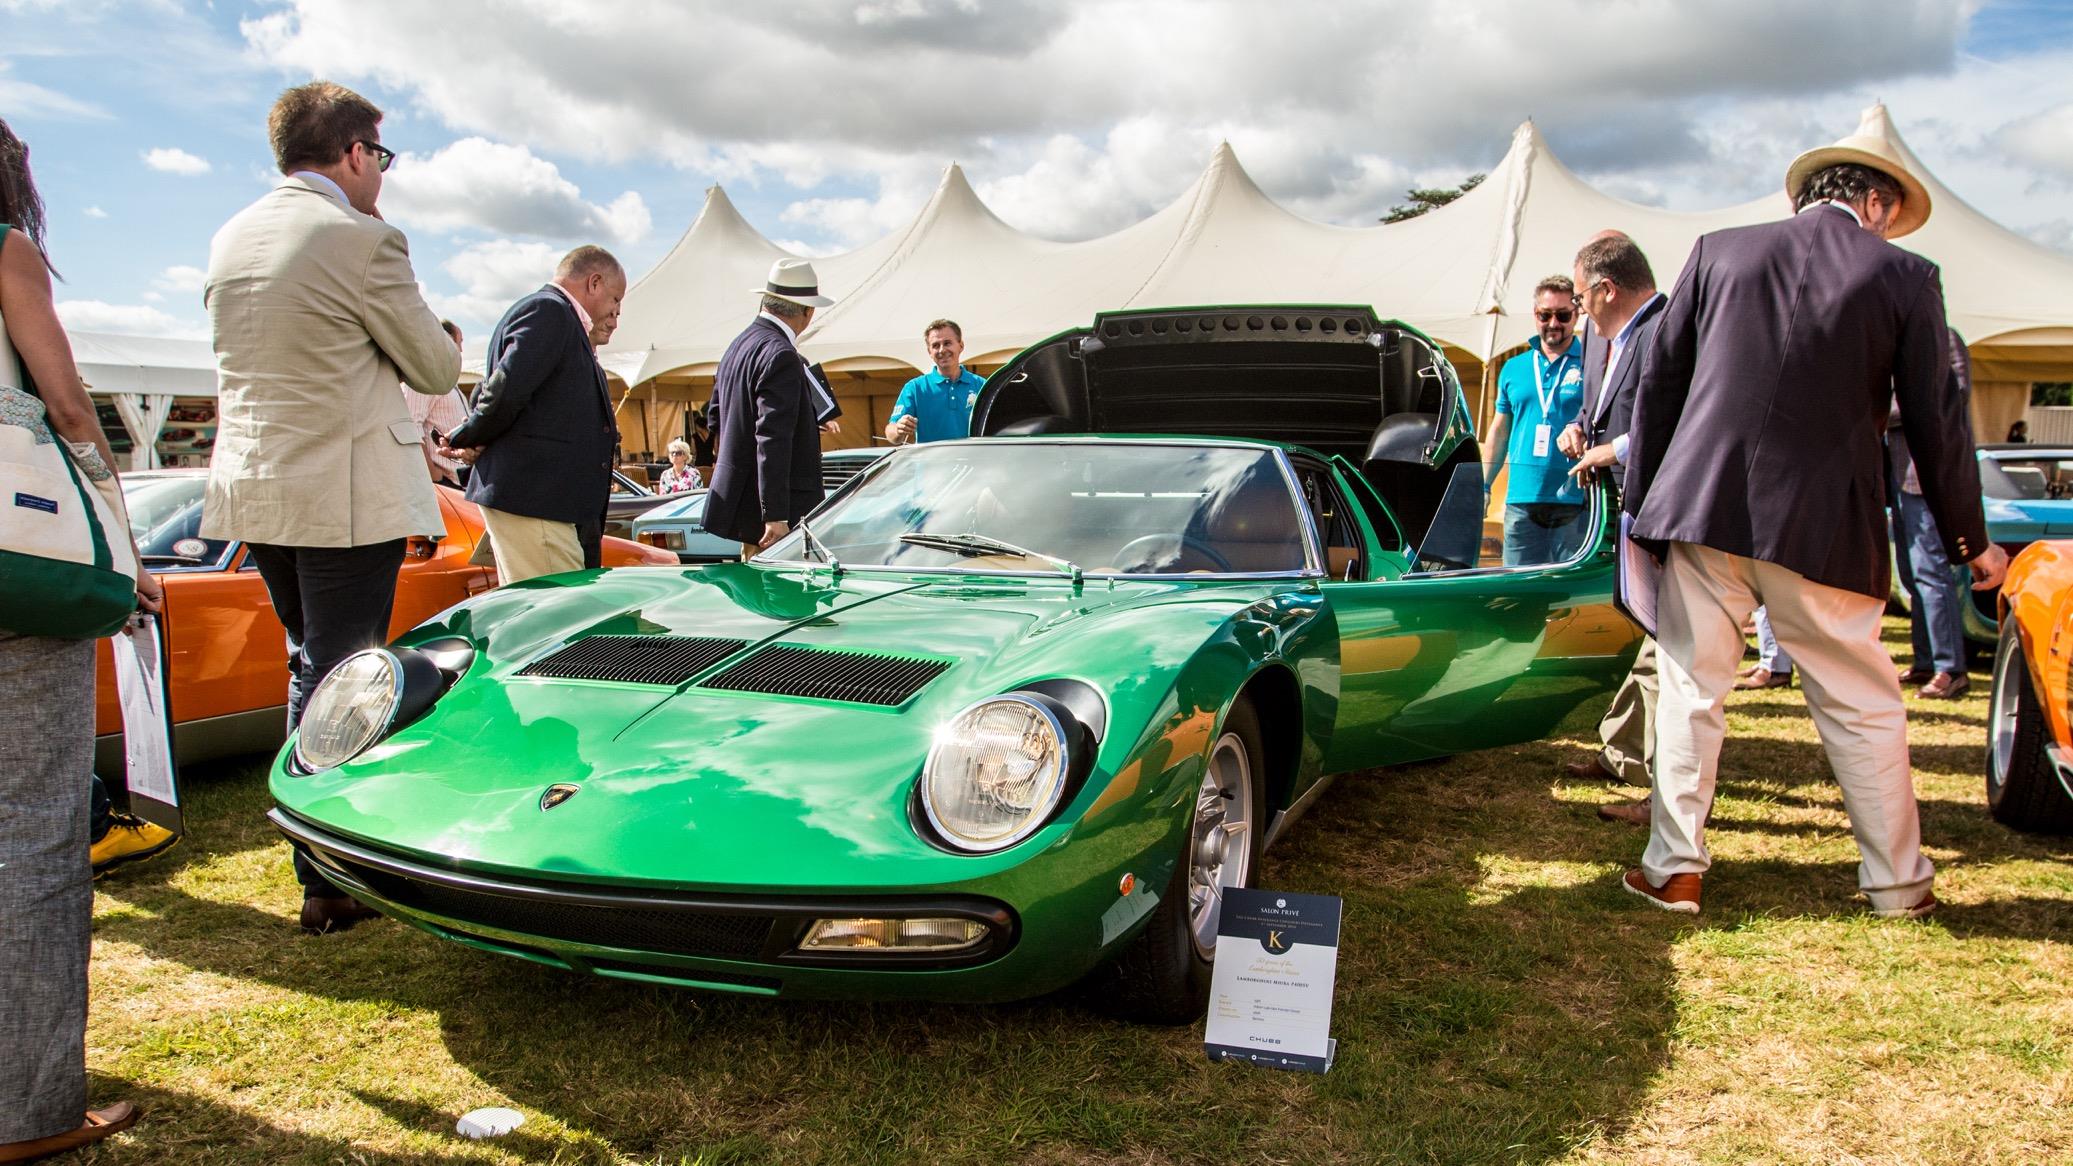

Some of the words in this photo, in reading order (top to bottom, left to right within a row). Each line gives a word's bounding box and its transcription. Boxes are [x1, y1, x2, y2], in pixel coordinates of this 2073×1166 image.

[1260, 907, 1280, 915] SALON
[1268, 930, 1285, 949] K
[1249, 1036, 1281, 1045] CHUBB
